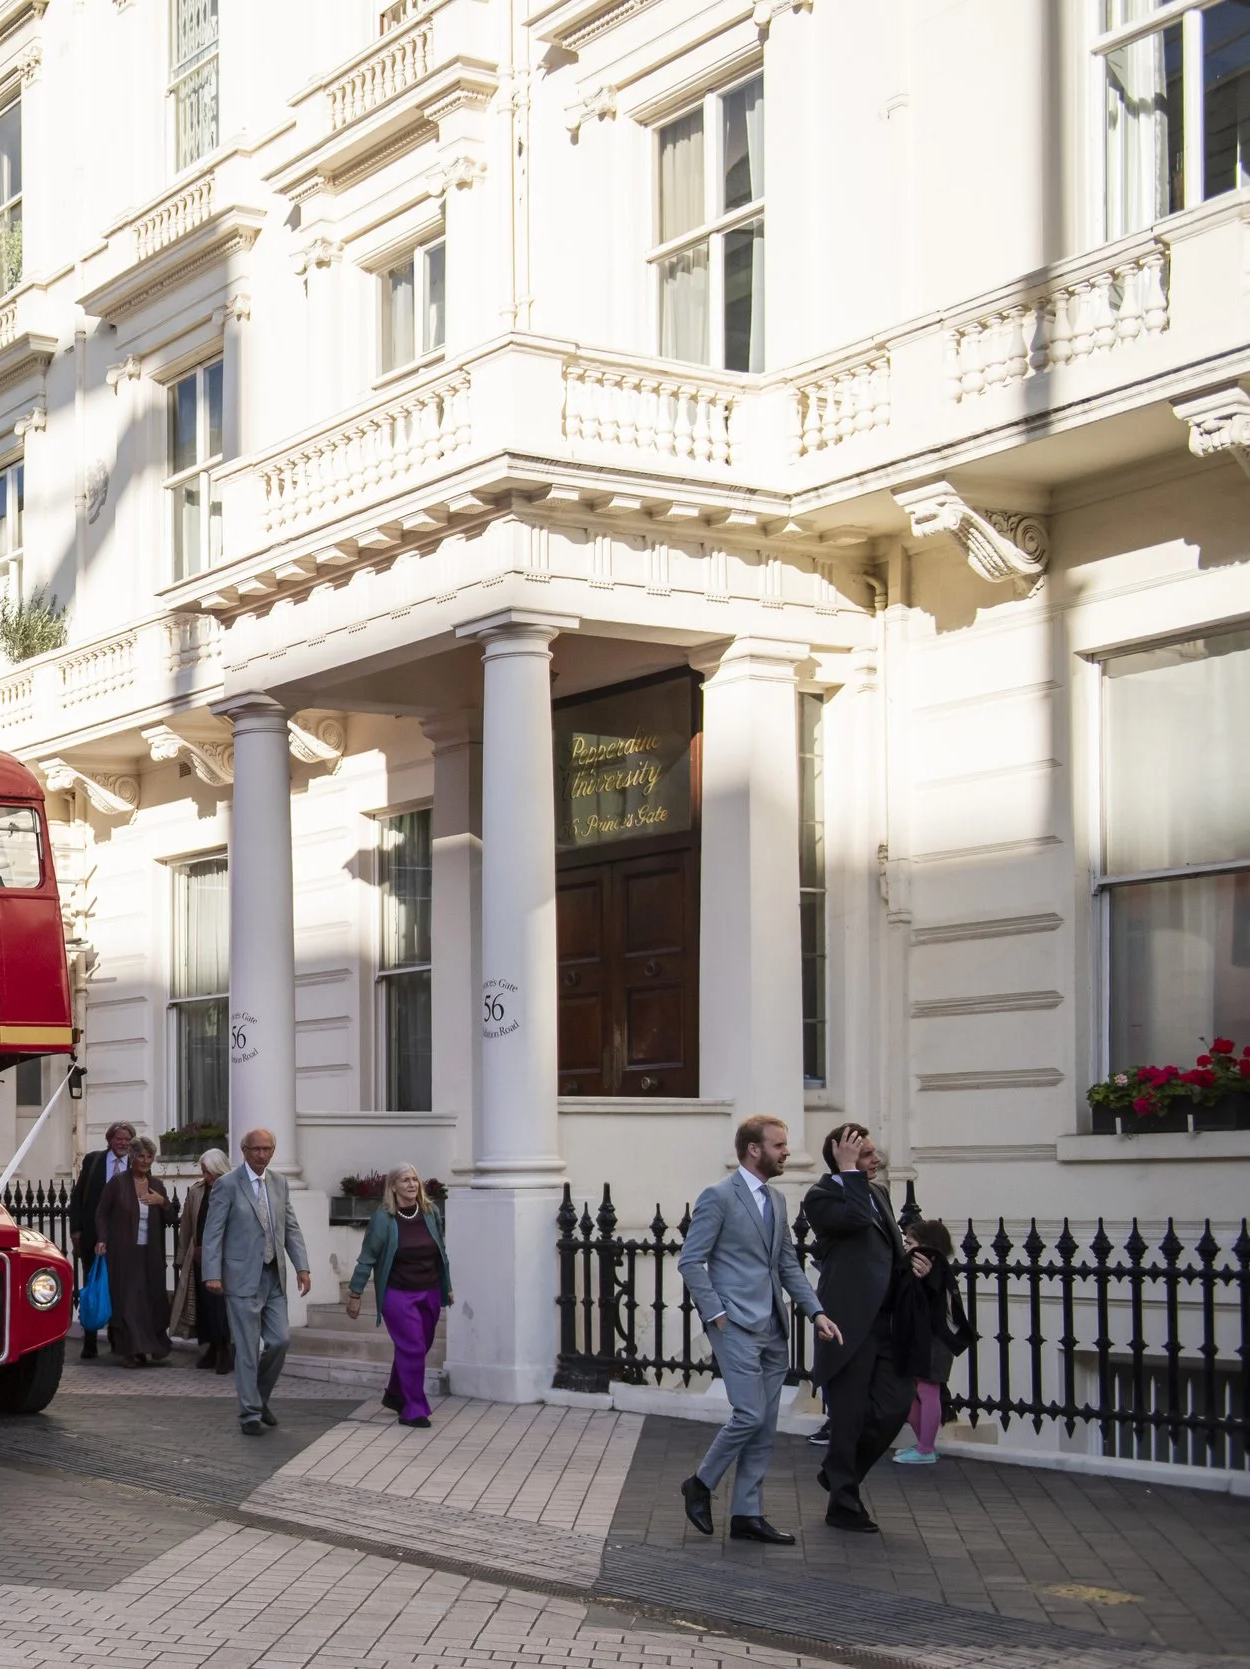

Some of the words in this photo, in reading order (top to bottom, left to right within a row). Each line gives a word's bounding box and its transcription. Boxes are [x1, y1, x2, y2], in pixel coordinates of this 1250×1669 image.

[571, 725, 660, 766] Pepperdine
[562, 761, 661, 799] University
[635, 804, 669, 827] Gate
[498, 978, 518, 993] Gate
[483, 992, 504, 1022] 56
[231, 1024, 246, 1050] 56
[499, 1019, 520, 1037] Road
